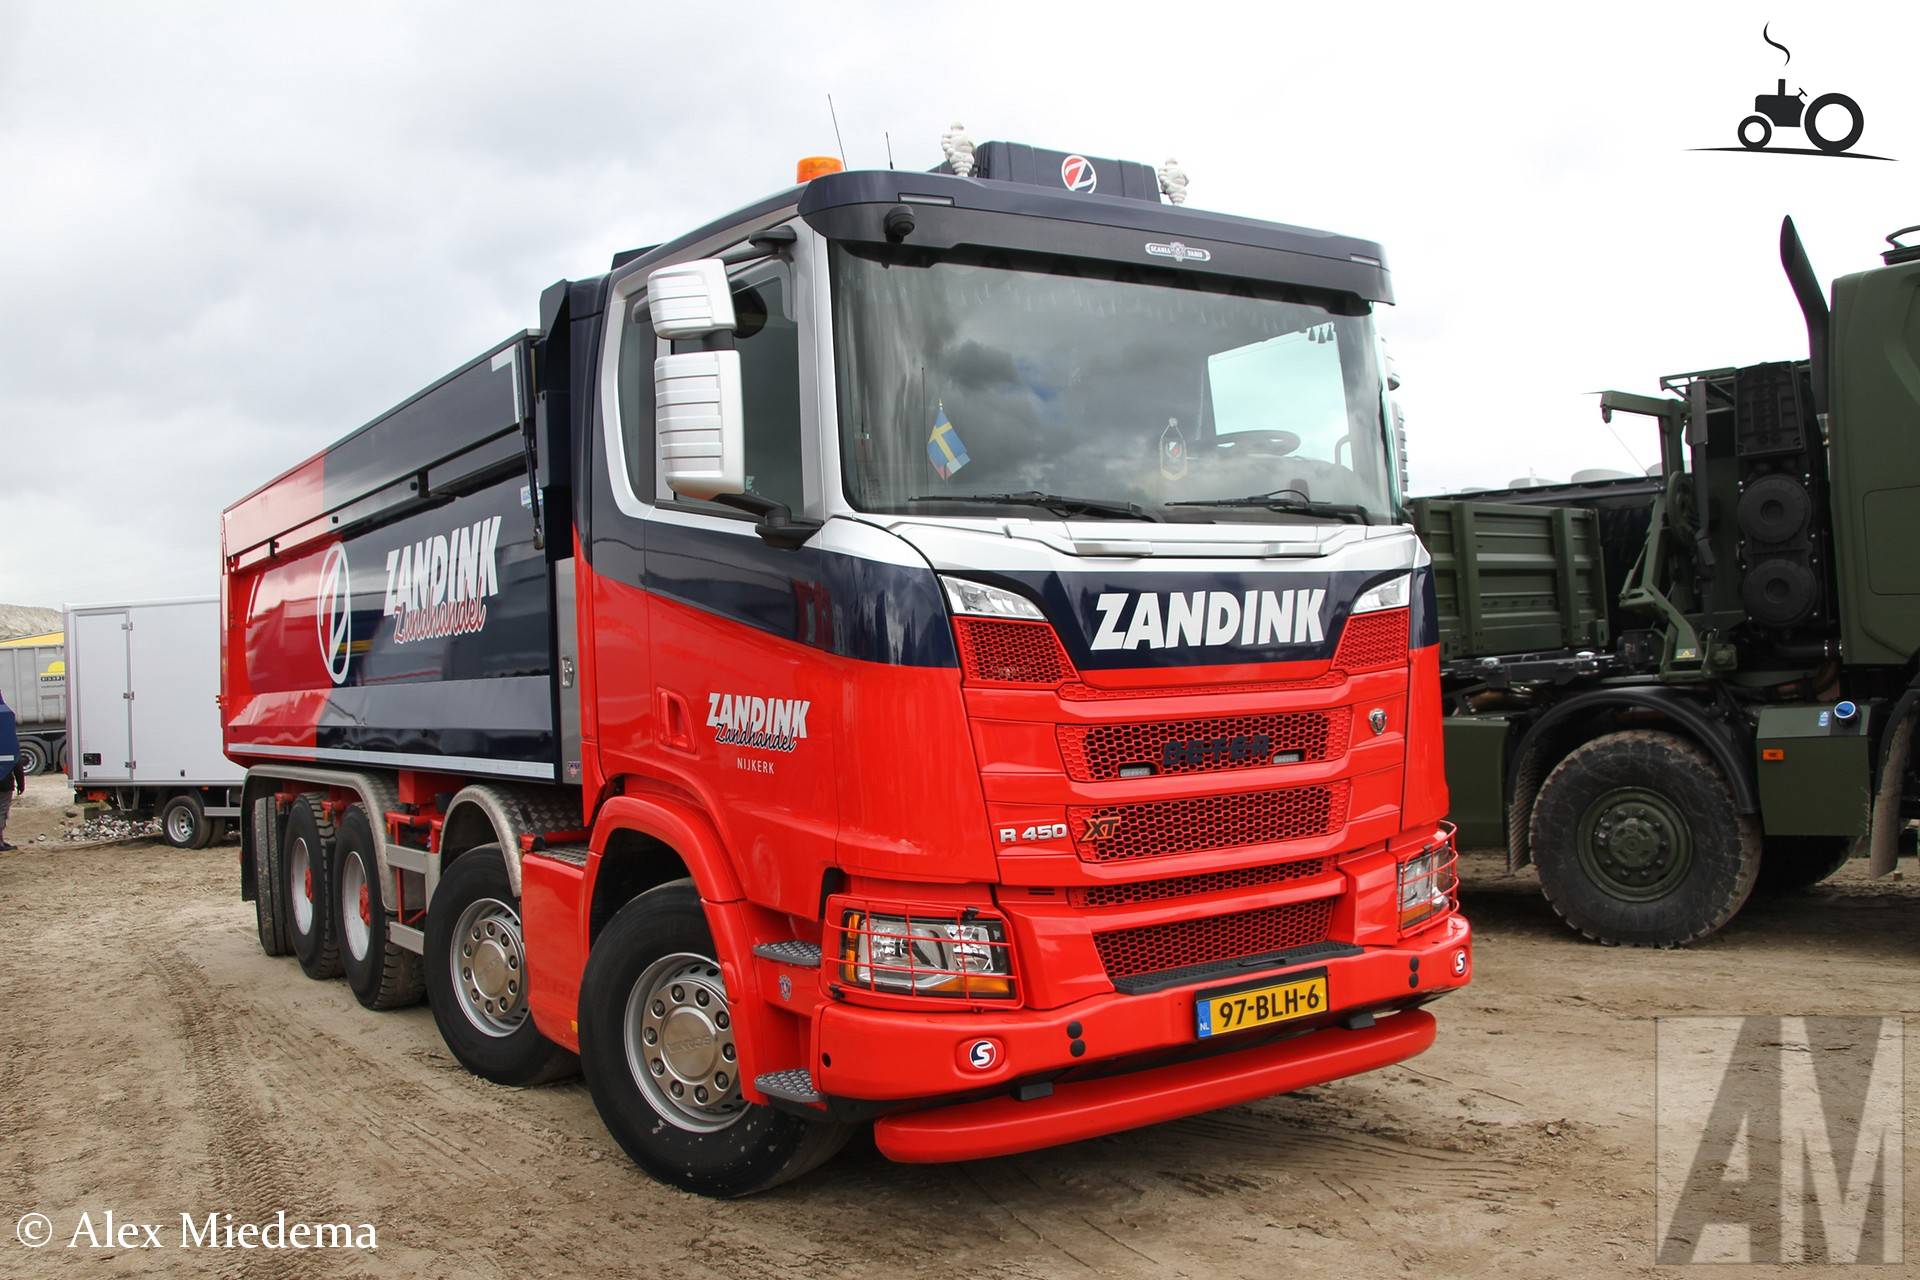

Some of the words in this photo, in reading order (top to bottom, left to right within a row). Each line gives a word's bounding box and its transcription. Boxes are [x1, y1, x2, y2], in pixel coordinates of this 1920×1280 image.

[383, 516, 502, 617] ZANDINK
[1090, 589, 1326, 650] ZANDINK
[706, 692, 811, 739] ZANDINK
[715, 721, 797, 752] Zandhandel
[737, 758, 775, 775] NIJKERK
[1000, 828, 1017, 843] R
[1022, 823, 1068, 841] 450
[1081, 817, 1122, 842] XT
[1200, 1022, 1210, 1031] NL
[1219, 984, 1320, 1028] 97-BLH-6
